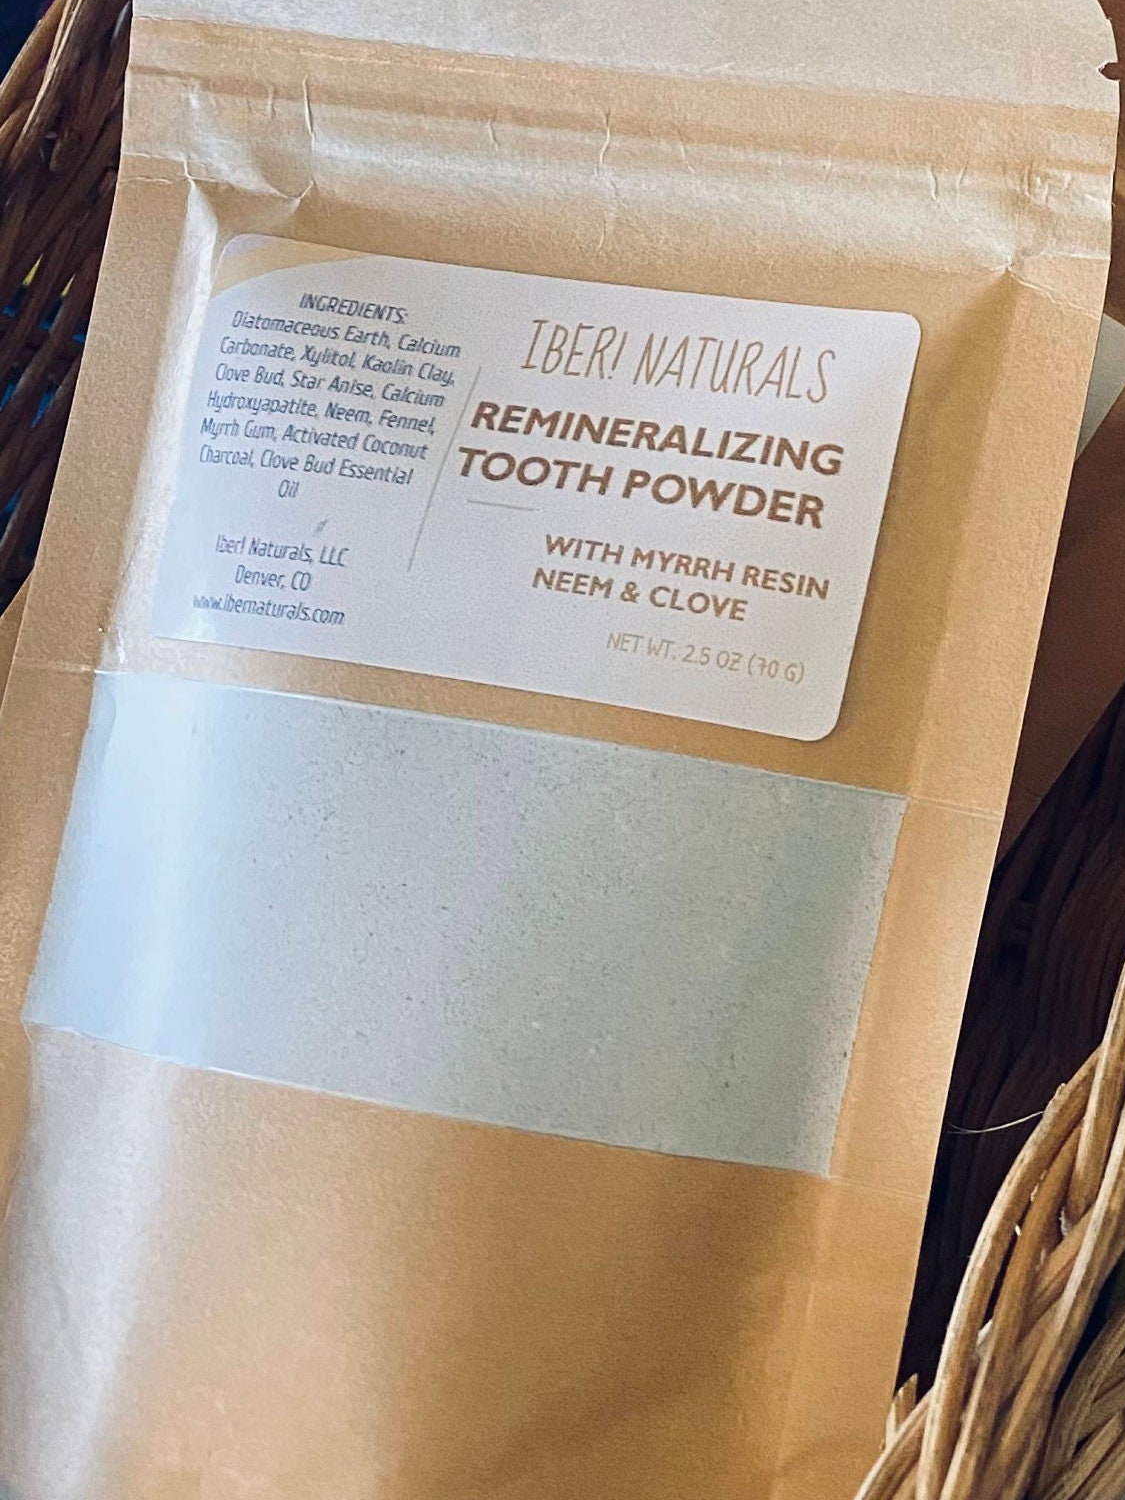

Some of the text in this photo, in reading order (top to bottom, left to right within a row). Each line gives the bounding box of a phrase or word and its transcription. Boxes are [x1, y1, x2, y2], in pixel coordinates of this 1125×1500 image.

[298, 293, 409, 325] INGREDIENTS:
[232, 310, 341, 341] Diatomaceous
[397, 333, 462, 358] Calcium
[215, 362, 251, 383] Clove
[289, 369, 326, 390] Star
[381, 382, 446, 408] Calcium
[361, 353, 414, 377] Kaolin
[632, 332, 836, 404] NATURALS
[200, 417, 241, 441] Myrrh
[281, 423, 361, 451] Activated
[361, 433, 429, 460] Coconut
[470, 400, 845, 476] REMINERALIZING
[260, 448, 300, 471] Clove
[302, 453, 337, 475] Bud
[337, 458, 415, 485] Essential
[277, 478, 300, 499] Oil
[458, 446, 825, 530] TOOTH POWDER
[247, 537, 314, 565] Naturals,
[318, 545, 350, 568] LLC
[545, 533, 830, 600] WITH MYRRH RESIN
[290, 570, 312, 592] CO
[532, 567, 749, 622] NEEM & CLOVE
[606, 632, 805, 685] NET WT. 2.5 OZ (70 G)
